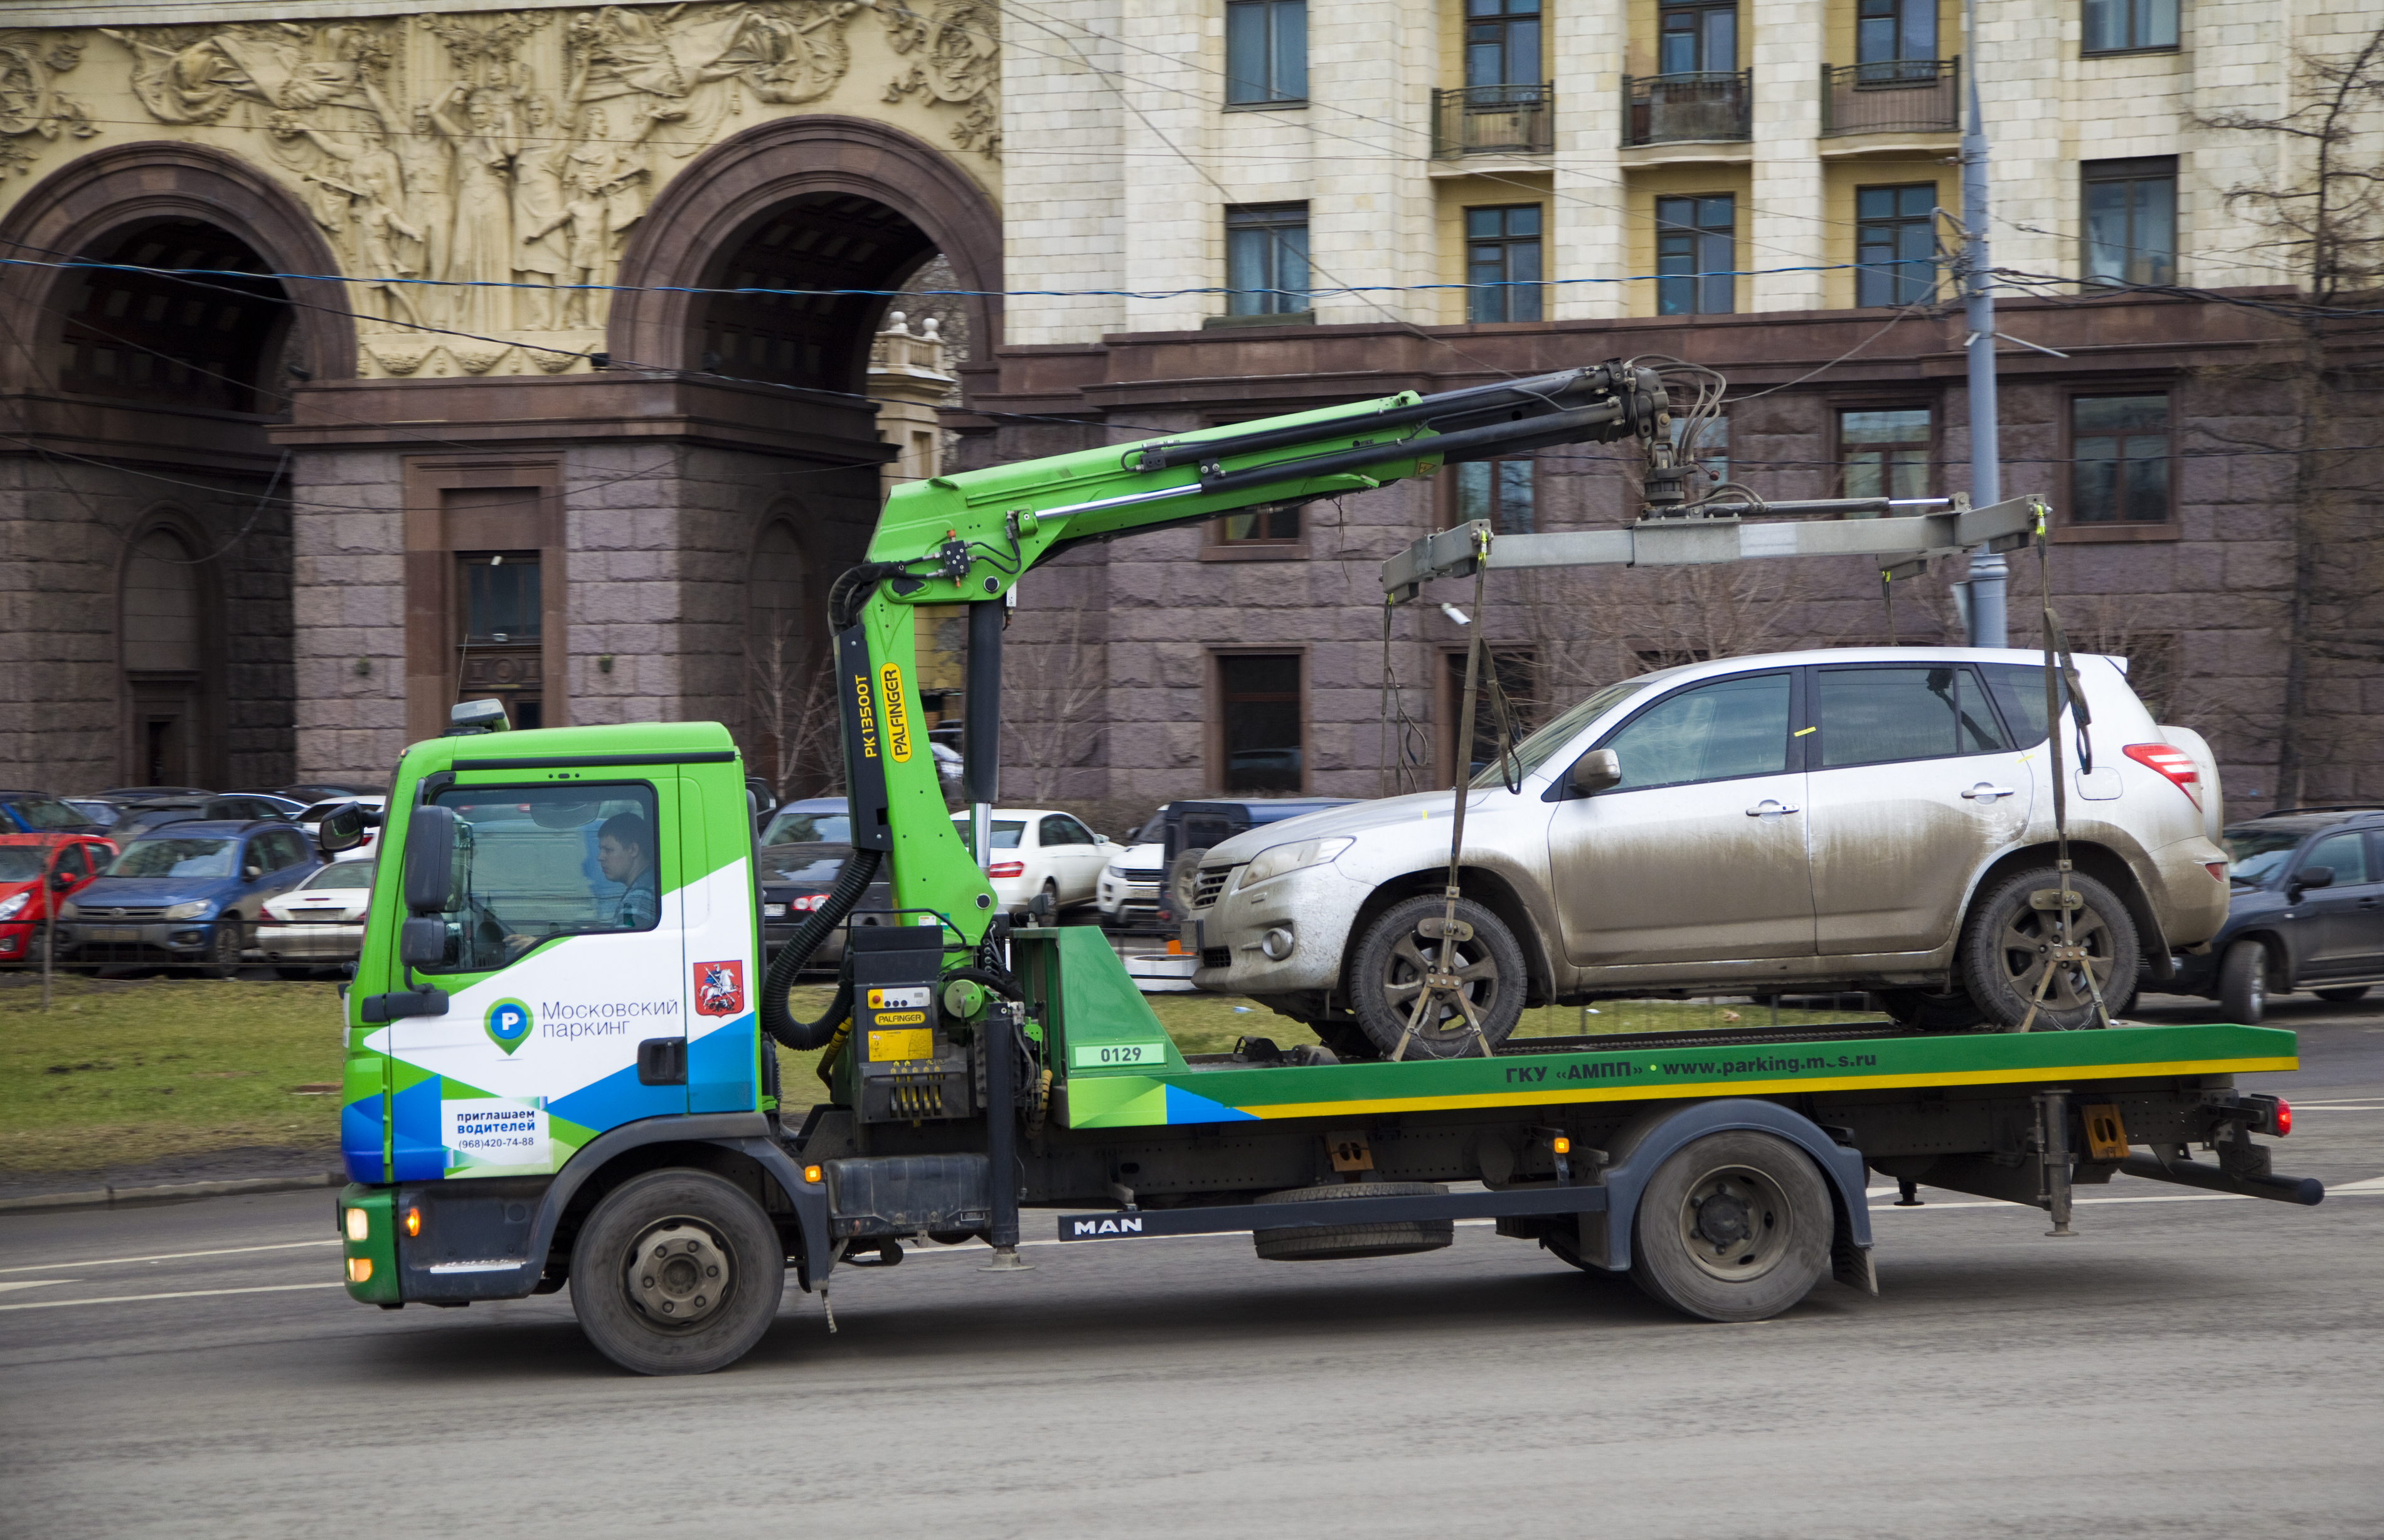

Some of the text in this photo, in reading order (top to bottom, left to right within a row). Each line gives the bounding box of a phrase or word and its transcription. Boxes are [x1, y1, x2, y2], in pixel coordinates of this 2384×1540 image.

[855, 674, 877, 758] PK 13500T
[884, 669, 908, 756] PALFINGER
[542, 999, 678, 1020] Московский
[502, 1012, 519, 1030] P
[878, 1014, 921, 1023] PALFINGER
[543, 1021, 630, 1041] паркинг
[1100, 1047, 1142, 1063] 0129
[1506, 1054, 1876, 1083] ГКУ «АМПП» www.parking.ms.ru
[457, 1110, 535, 1123] приглашаем
[457, 1120, 535, 1135] водителей
[459, 1137, 534, 1150] (968)420-74-88
[1074, 1218, 1142, 1235] MAN
